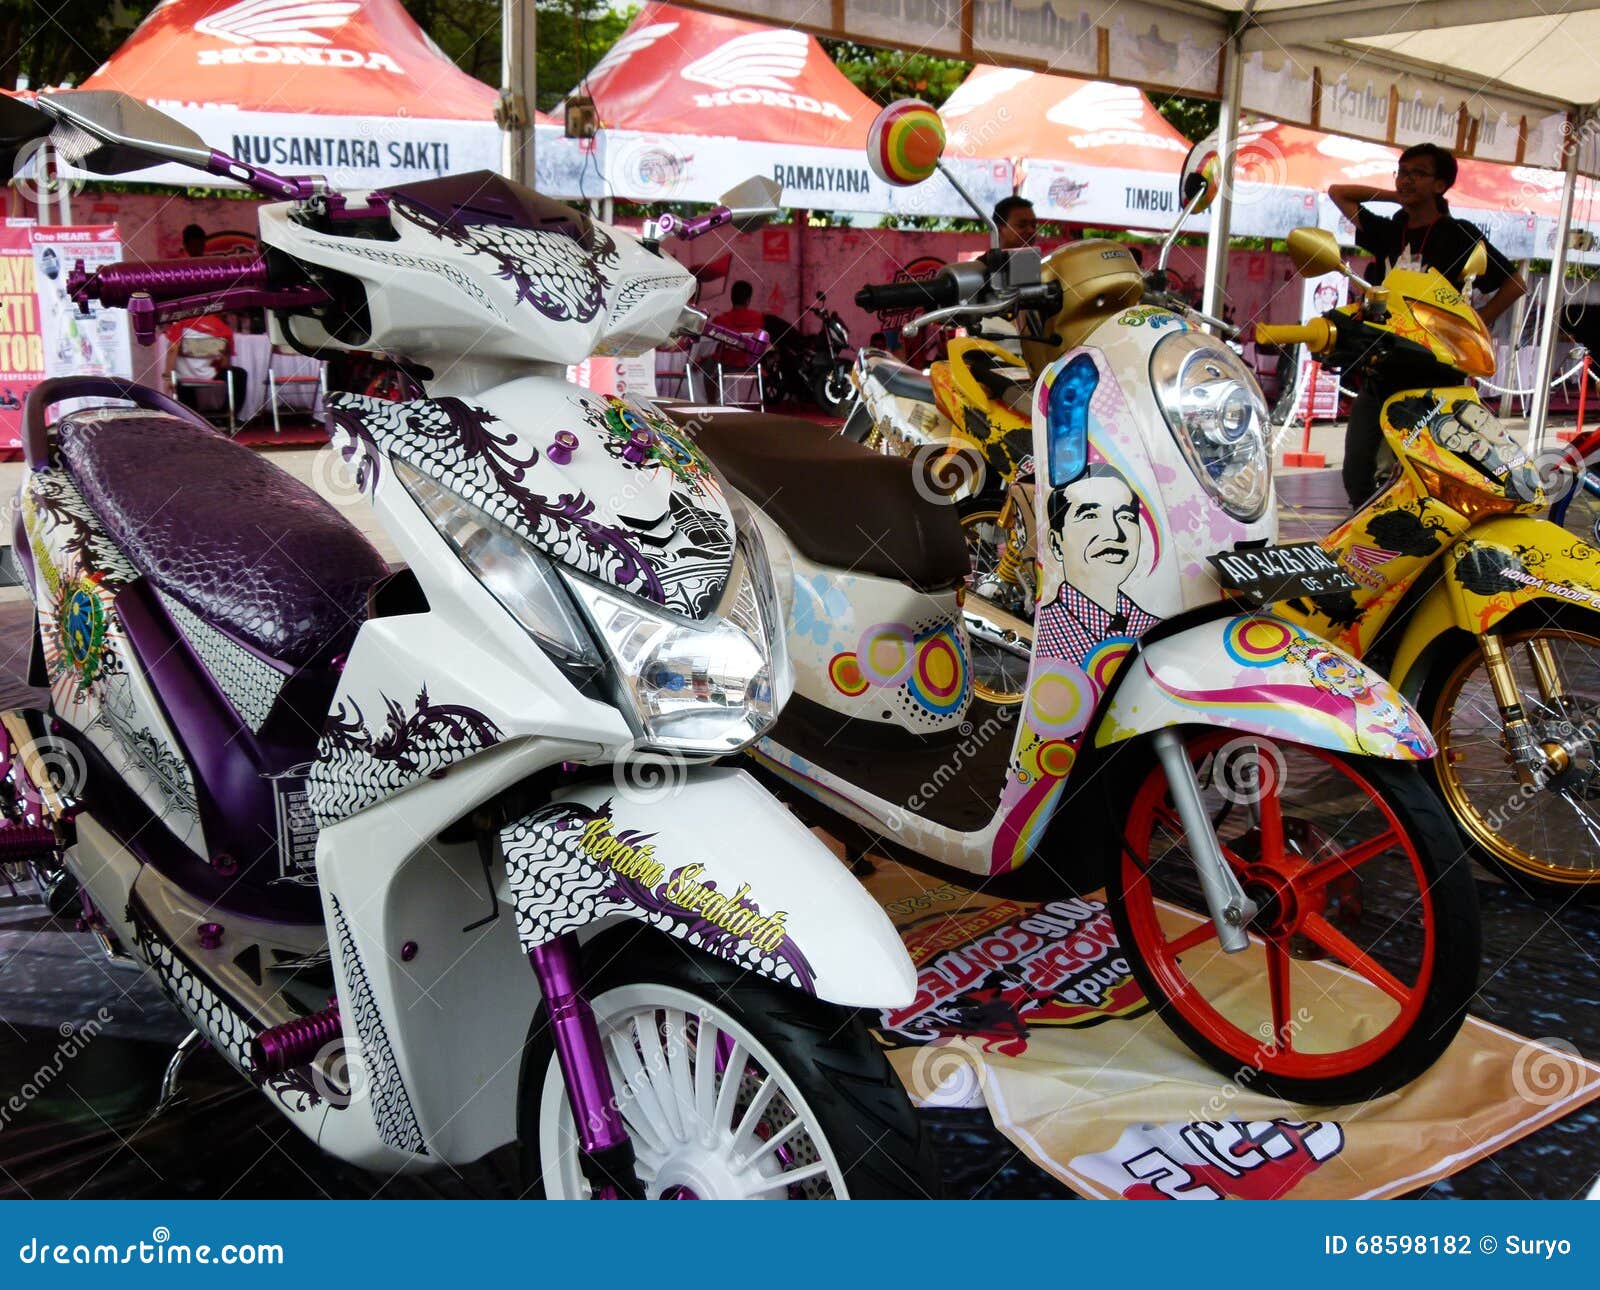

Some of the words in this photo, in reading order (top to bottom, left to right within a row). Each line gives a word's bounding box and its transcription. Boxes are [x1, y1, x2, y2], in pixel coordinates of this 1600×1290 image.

[197, 46, 405, 74] HONDA
[693, 88, 852, 122] HONDA
[232, 134, 380, 168] NUSANTARA
[387, 141, 449, 172] SAKTI
[774, 164, 870, 194] RAMAYANA
[1126, 187, 1174, 213] TIMBUL
[34, 232, 55, 242] One
[0, 256, 36, 294] AYA
[0, 296, 35, 333] KTI
[0, 334, 44, 373] TOR
[1219, 556, 1259, 583] AD
[1246, 550, 1306, 577] 3426
[1296, 545, 1339, 571] DAC
[1301, 576, 1324, 591] 05
[1333, 573, 1356, 587] 20
[1500, 567, 1545, 588] HONDA
[1546, 583, 1592, 602] MODIF
[577, 816, 666, 889] Keraton
[665, 862, 789, 954] Surakarta
[1017, 898, 1107, 939] 2016
[1020, 915, 1118, 992] MODIF
[879, 925, 1044, 1030] CONTEST
[1061, 957, 1131, 1005] onda
